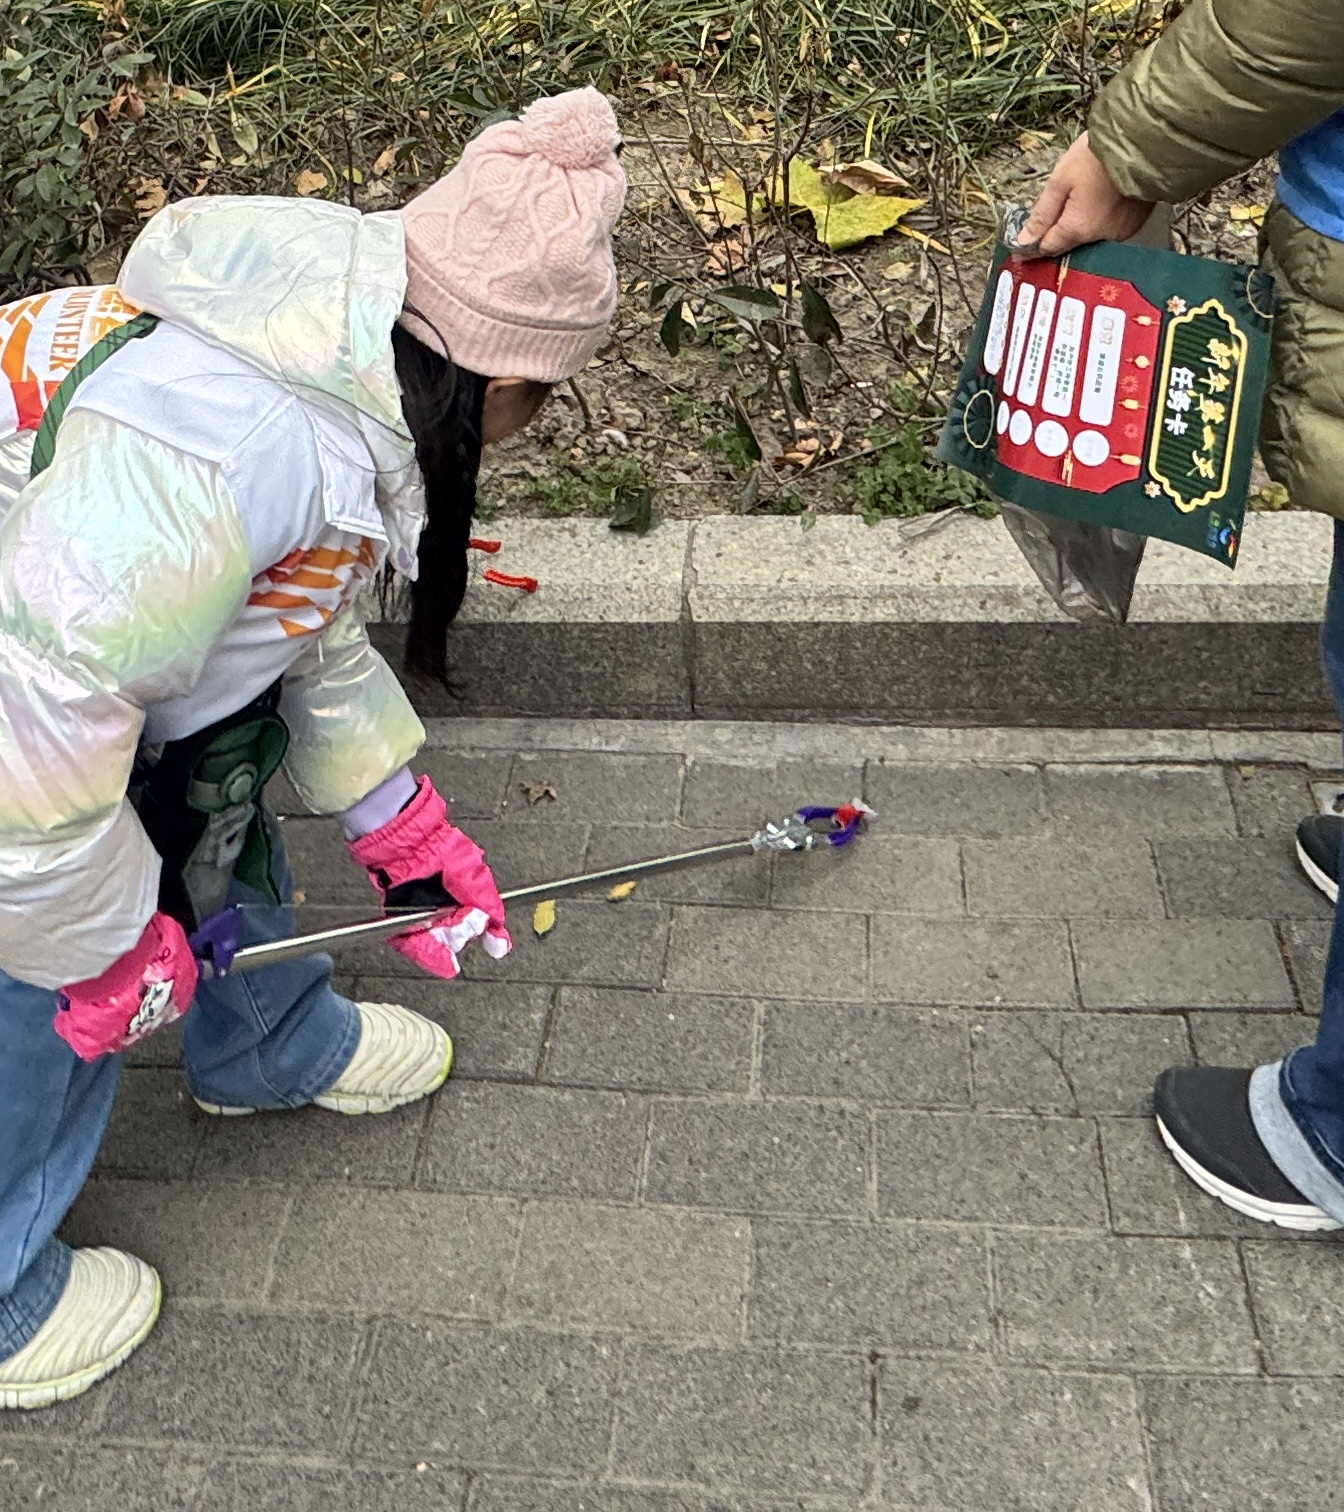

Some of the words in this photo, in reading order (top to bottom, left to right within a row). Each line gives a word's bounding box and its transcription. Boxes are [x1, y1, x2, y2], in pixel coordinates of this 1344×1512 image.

[1164, 366, 1196, 436] 任务卡
[1193, 338, 1234, 479] 新年第一天
